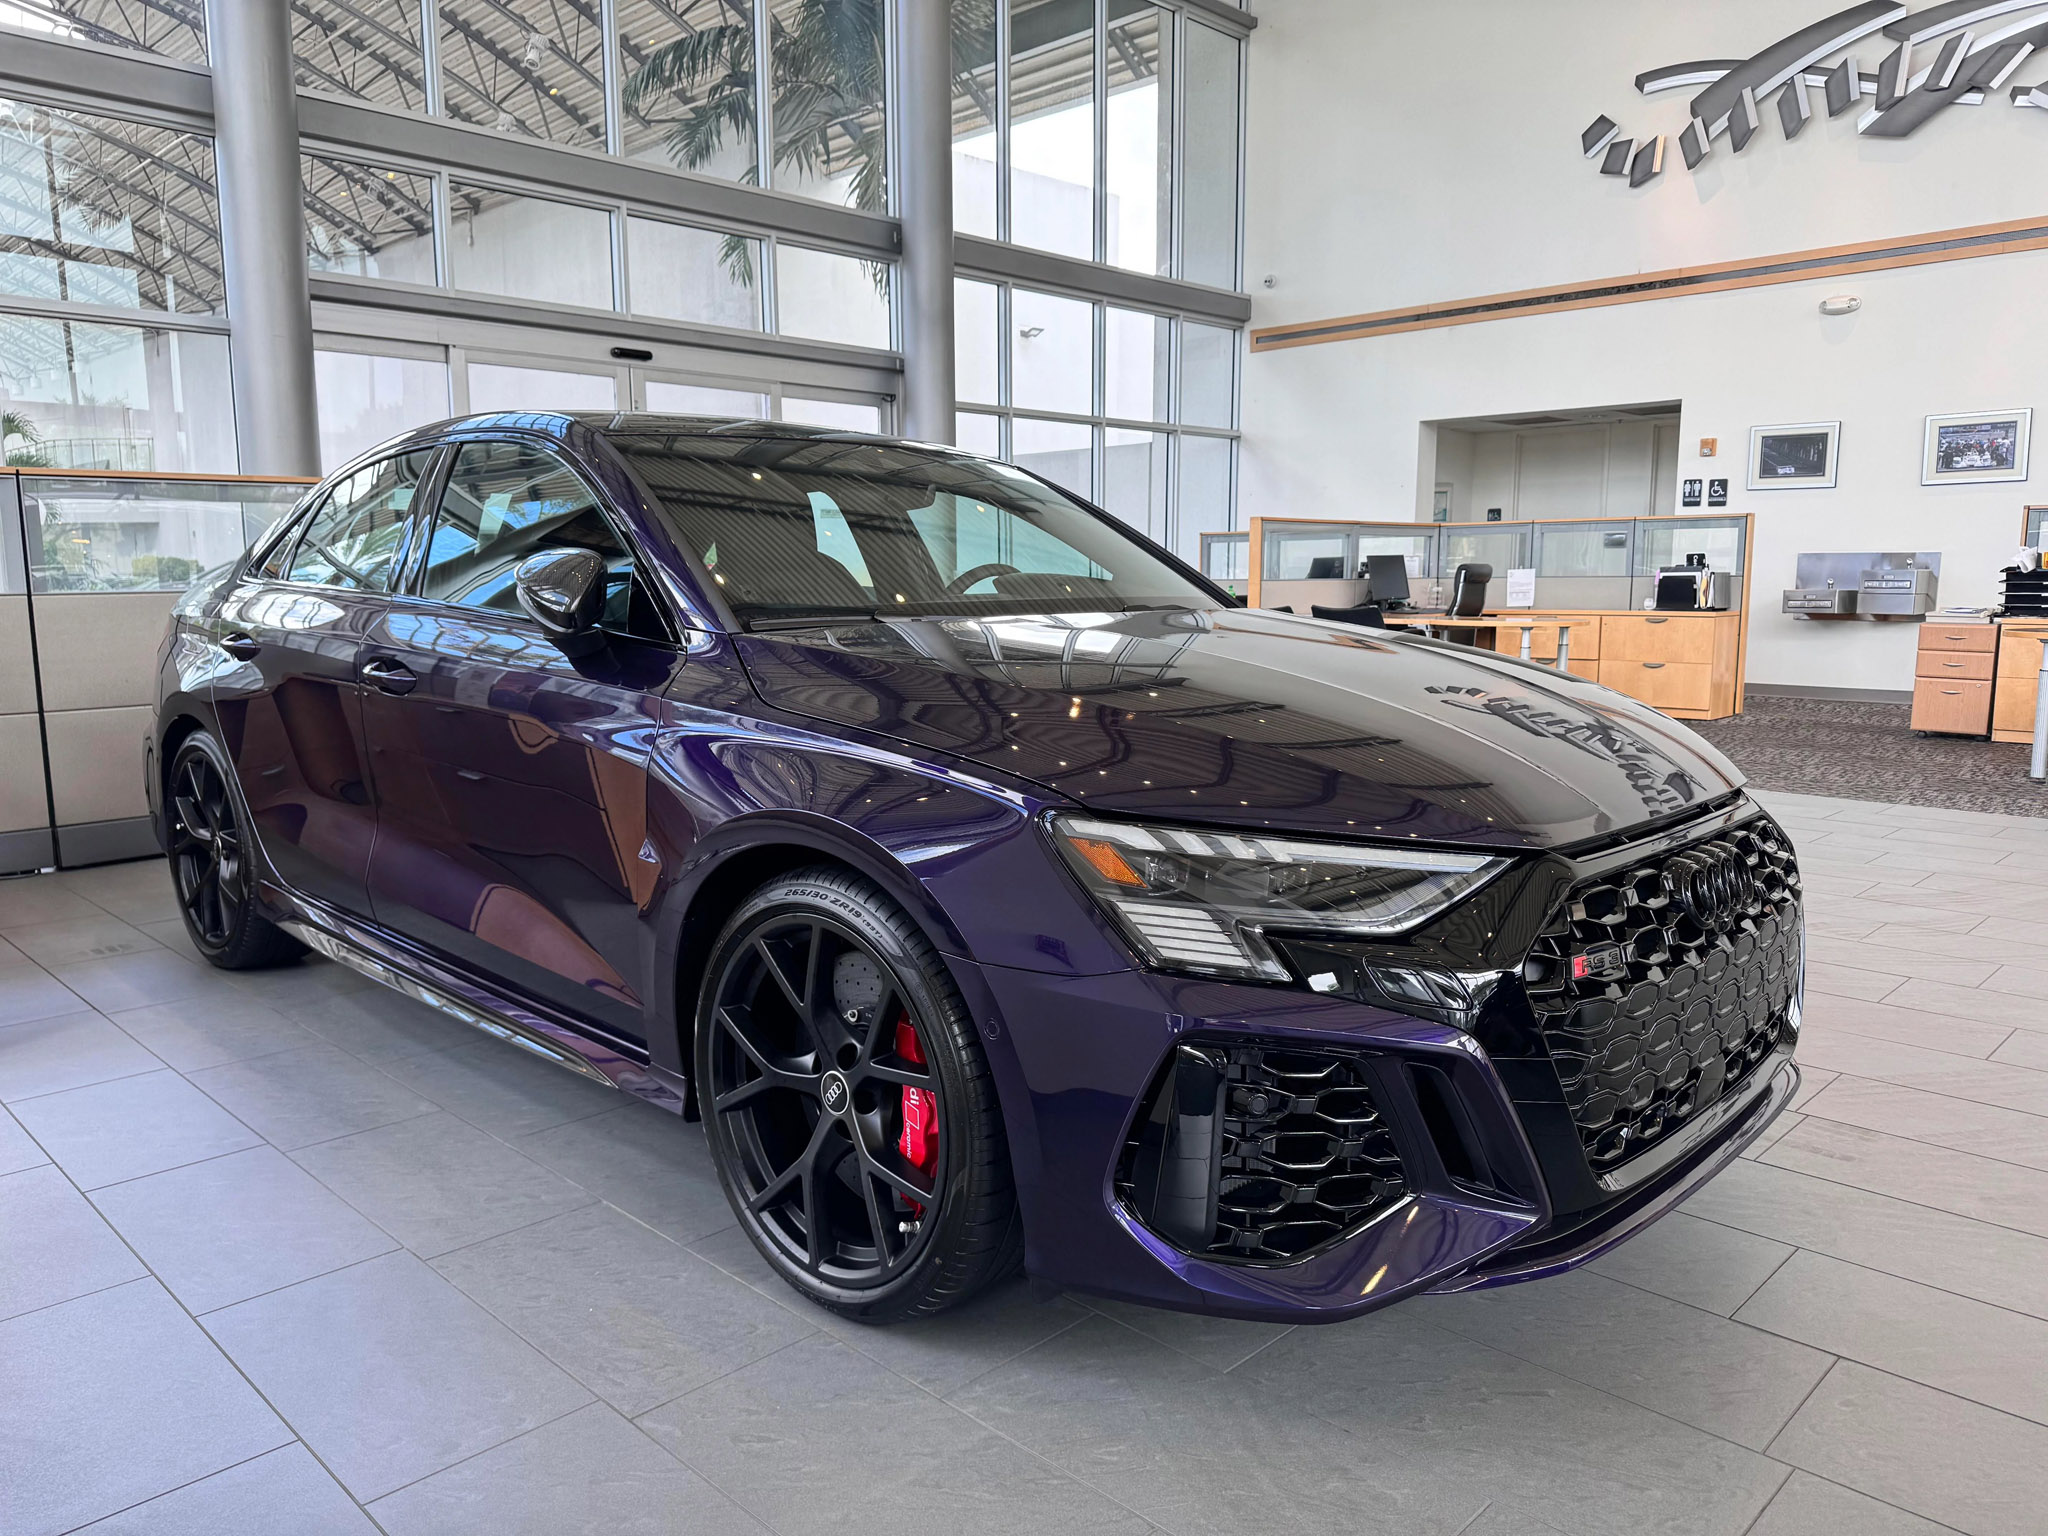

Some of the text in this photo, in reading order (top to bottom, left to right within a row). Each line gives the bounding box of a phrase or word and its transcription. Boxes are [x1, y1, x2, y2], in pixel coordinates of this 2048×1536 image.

[784, 888, 829, 901] 265/30
[829, 897, 863, 919] ZR19
[1581, 950, 1619, 973] RS 3
[909, 1087, 920, 1105] di
